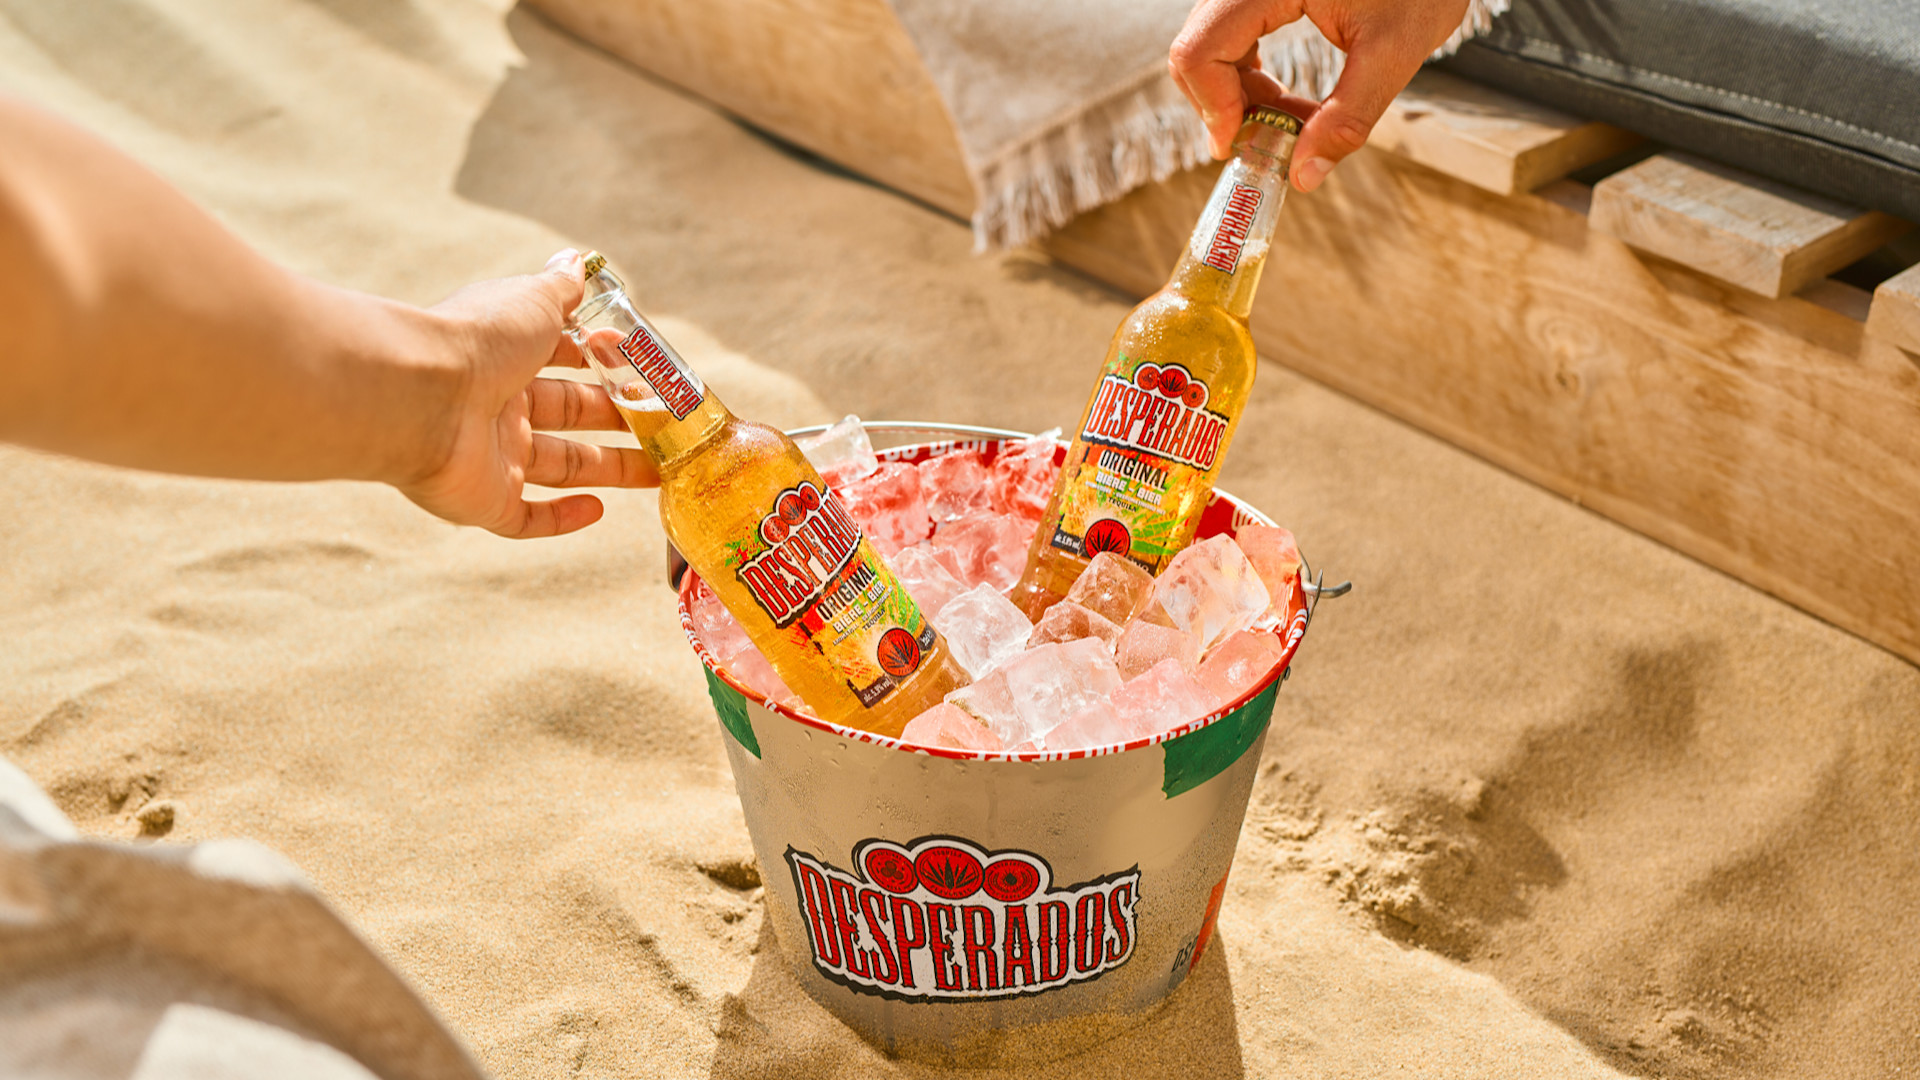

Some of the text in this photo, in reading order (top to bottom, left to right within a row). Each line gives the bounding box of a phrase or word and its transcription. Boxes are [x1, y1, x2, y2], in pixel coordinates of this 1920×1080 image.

[1205, 183, 1263, 274] DESPERADOS
[621, 328, 702, 418] DESPERADOS
[1086, 379, 1227, 469] DESPERADOS
[1098, 449, 1168, 492] ORIGINAL
[1136, 487, 1162, 506] BIER
[1108, 497, 1137, 512] TEQUILA
[815, 561, 877, 623] ORIGINAL
[867, 580, 886, 603] BIER
[862, 608, 886, 631] TEQUILA
[799, 861, 1134, 991] DESPERADOS
